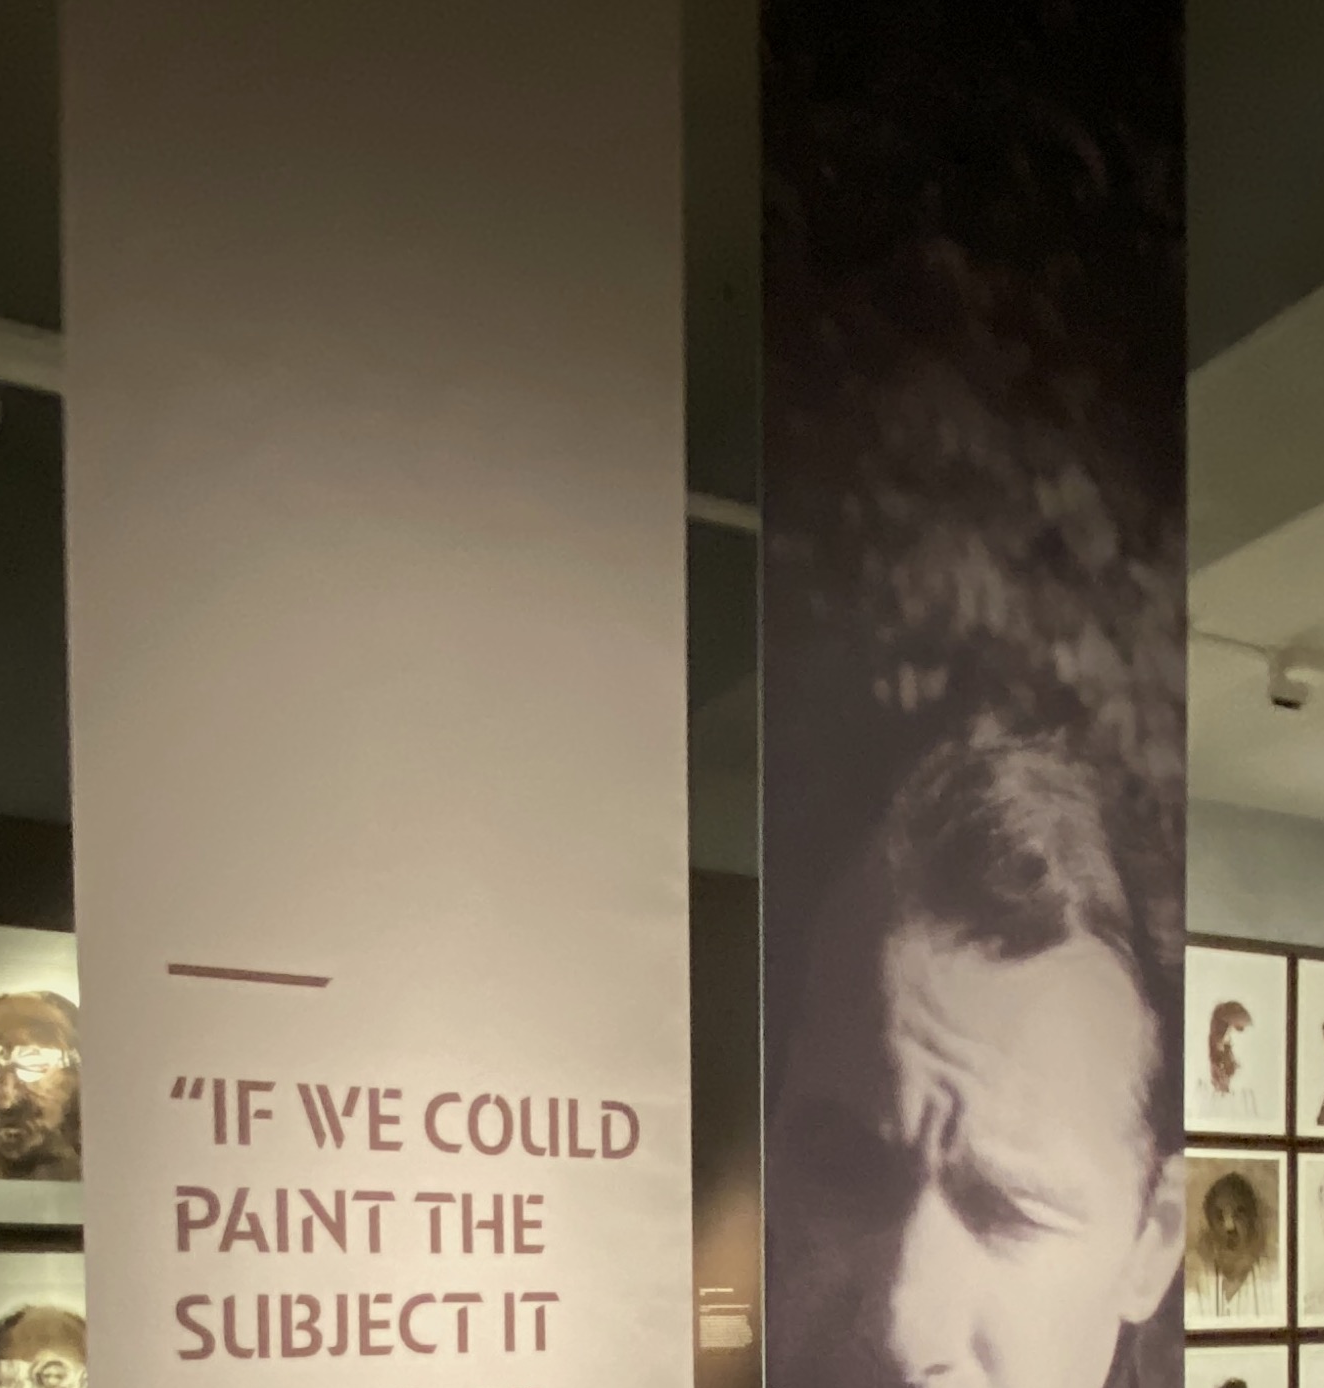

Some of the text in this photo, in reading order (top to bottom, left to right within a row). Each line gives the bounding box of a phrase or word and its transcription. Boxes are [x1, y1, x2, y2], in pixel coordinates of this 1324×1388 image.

[296, 1082, 403, 1152] WE
[424, 1090, 640, 1160] COULD
[174, 1185, 546, 1255] PAINT THE
[175, 1291, 559, 1360] SUBJECT IT
